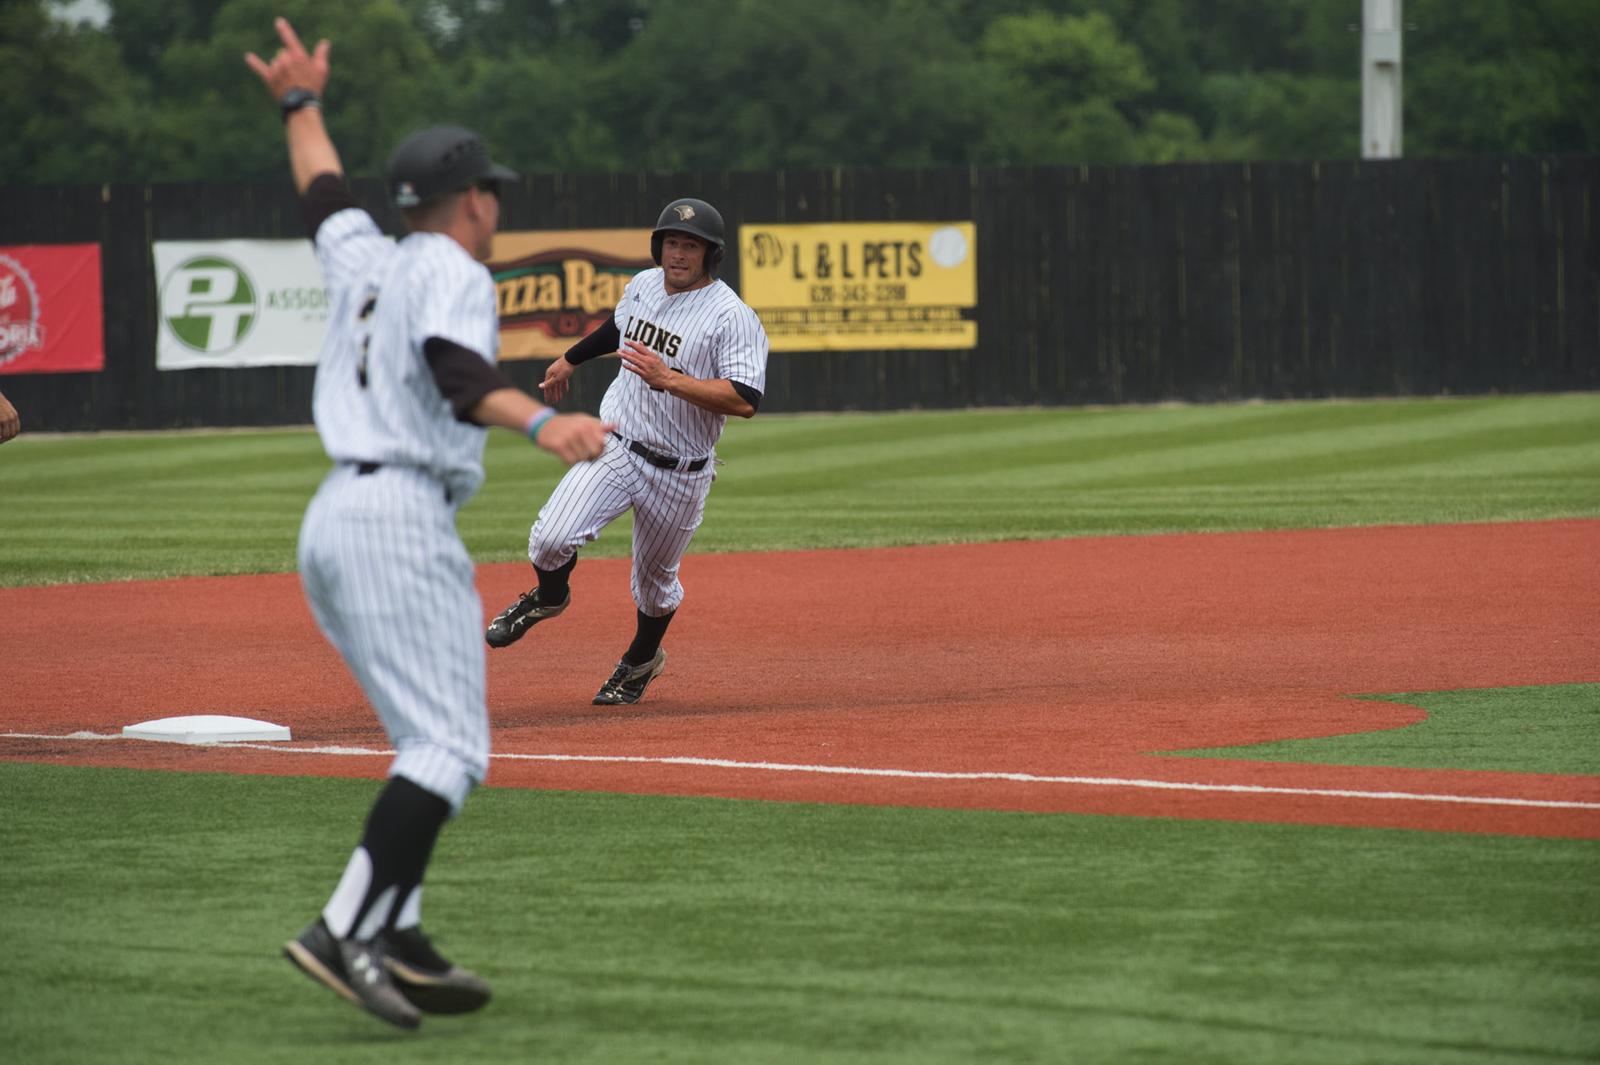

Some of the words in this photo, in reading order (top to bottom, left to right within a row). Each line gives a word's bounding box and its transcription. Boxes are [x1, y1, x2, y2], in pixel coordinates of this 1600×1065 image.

[793, 243, 805, 279] L
[816, 242, 831, 279] &
[842, 243, 854, 279] L
[863, 241, 922, 278] PETS
[496, 274, 562, 317] zza
[623, 315, 682, 358] LIONS
